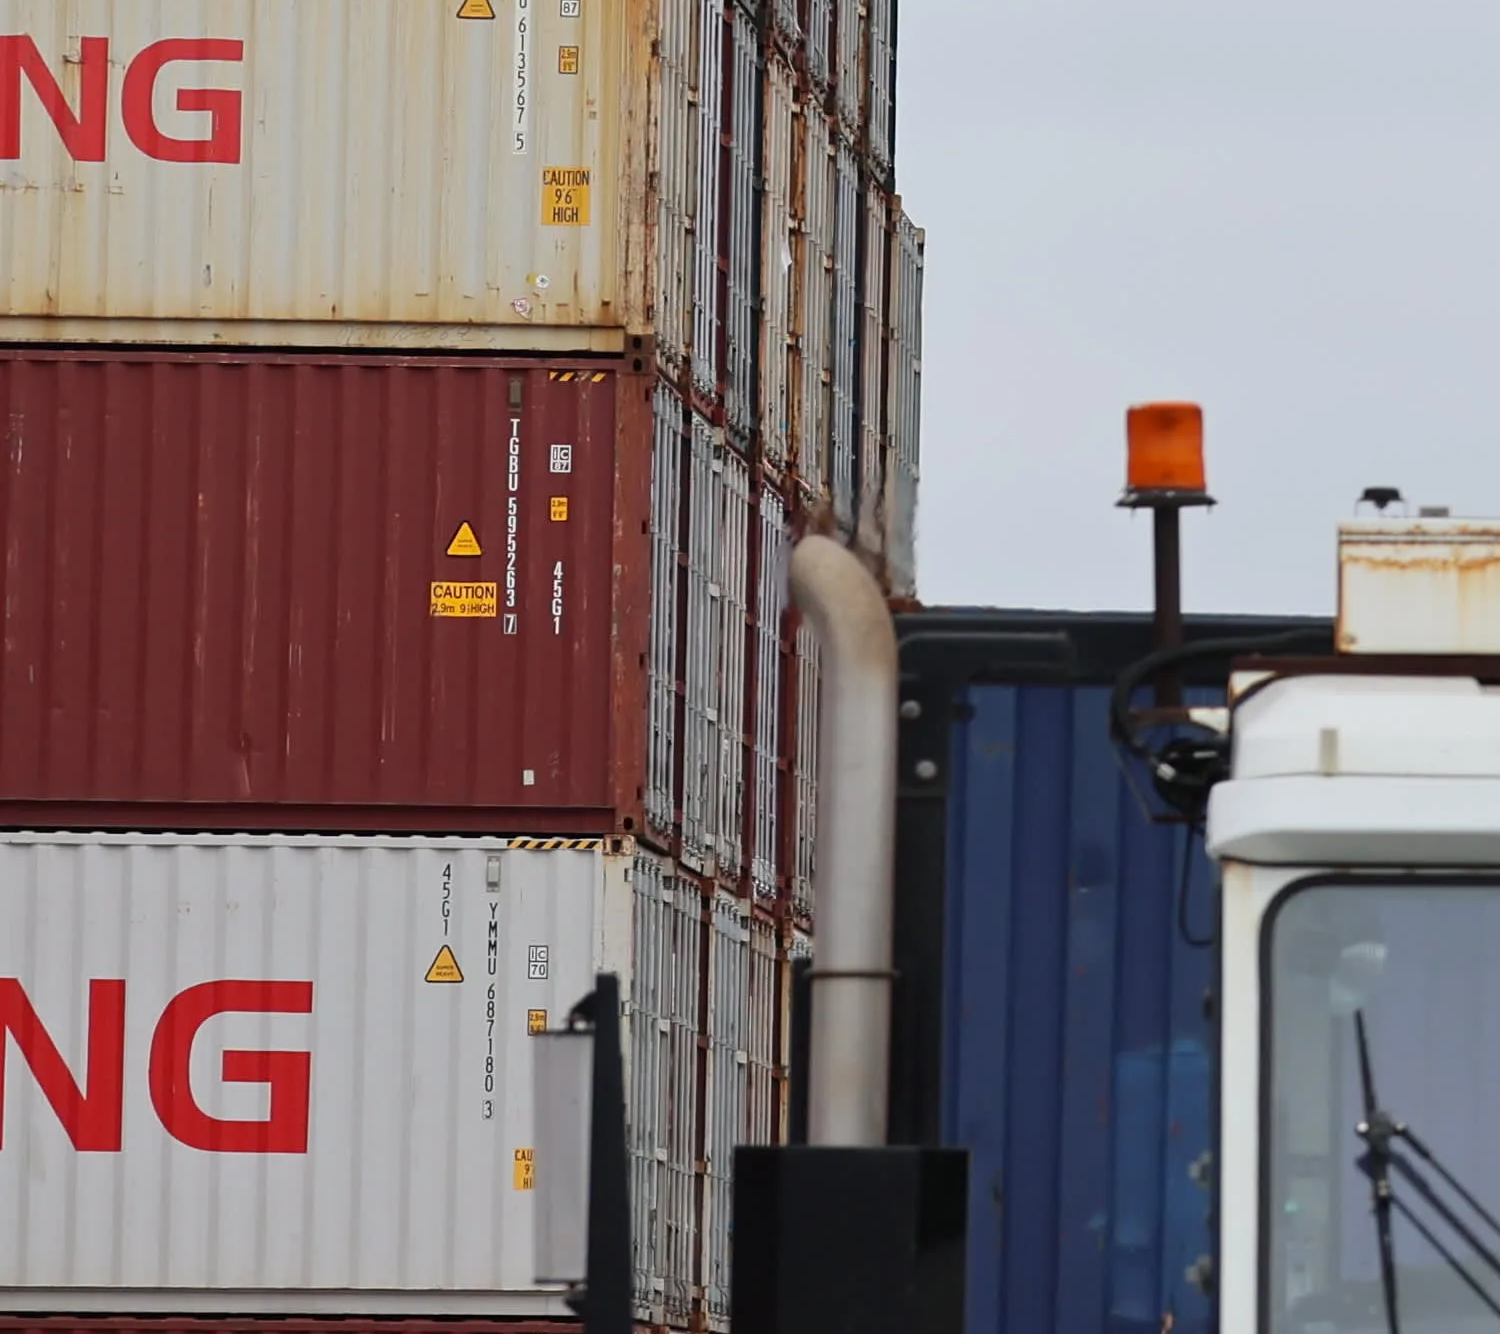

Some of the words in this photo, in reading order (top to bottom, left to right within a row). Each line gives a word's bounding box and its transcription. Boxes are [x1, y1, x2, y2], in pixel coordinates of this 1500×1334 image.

[517, 17, 527, 124] 613567
[516, 133, 525, 151] 5
[543, 170, 590, 186] CAUTION
[552, 207, 579, 222] HIGH
[508, 418, 521, 492] TGBU
[506, 497, 517, 607] 595263
[432, 585, 495, 599] CAUTION
[505, 615, 516, 634] 7
[552, 561, 563, 635] 45G1
[441, 864, 452, 936] 45G1
[487, 902, 499, 975] YMMU
[531, 964, 546, 977] 70
[484, 983, 496, 1093] 687180
